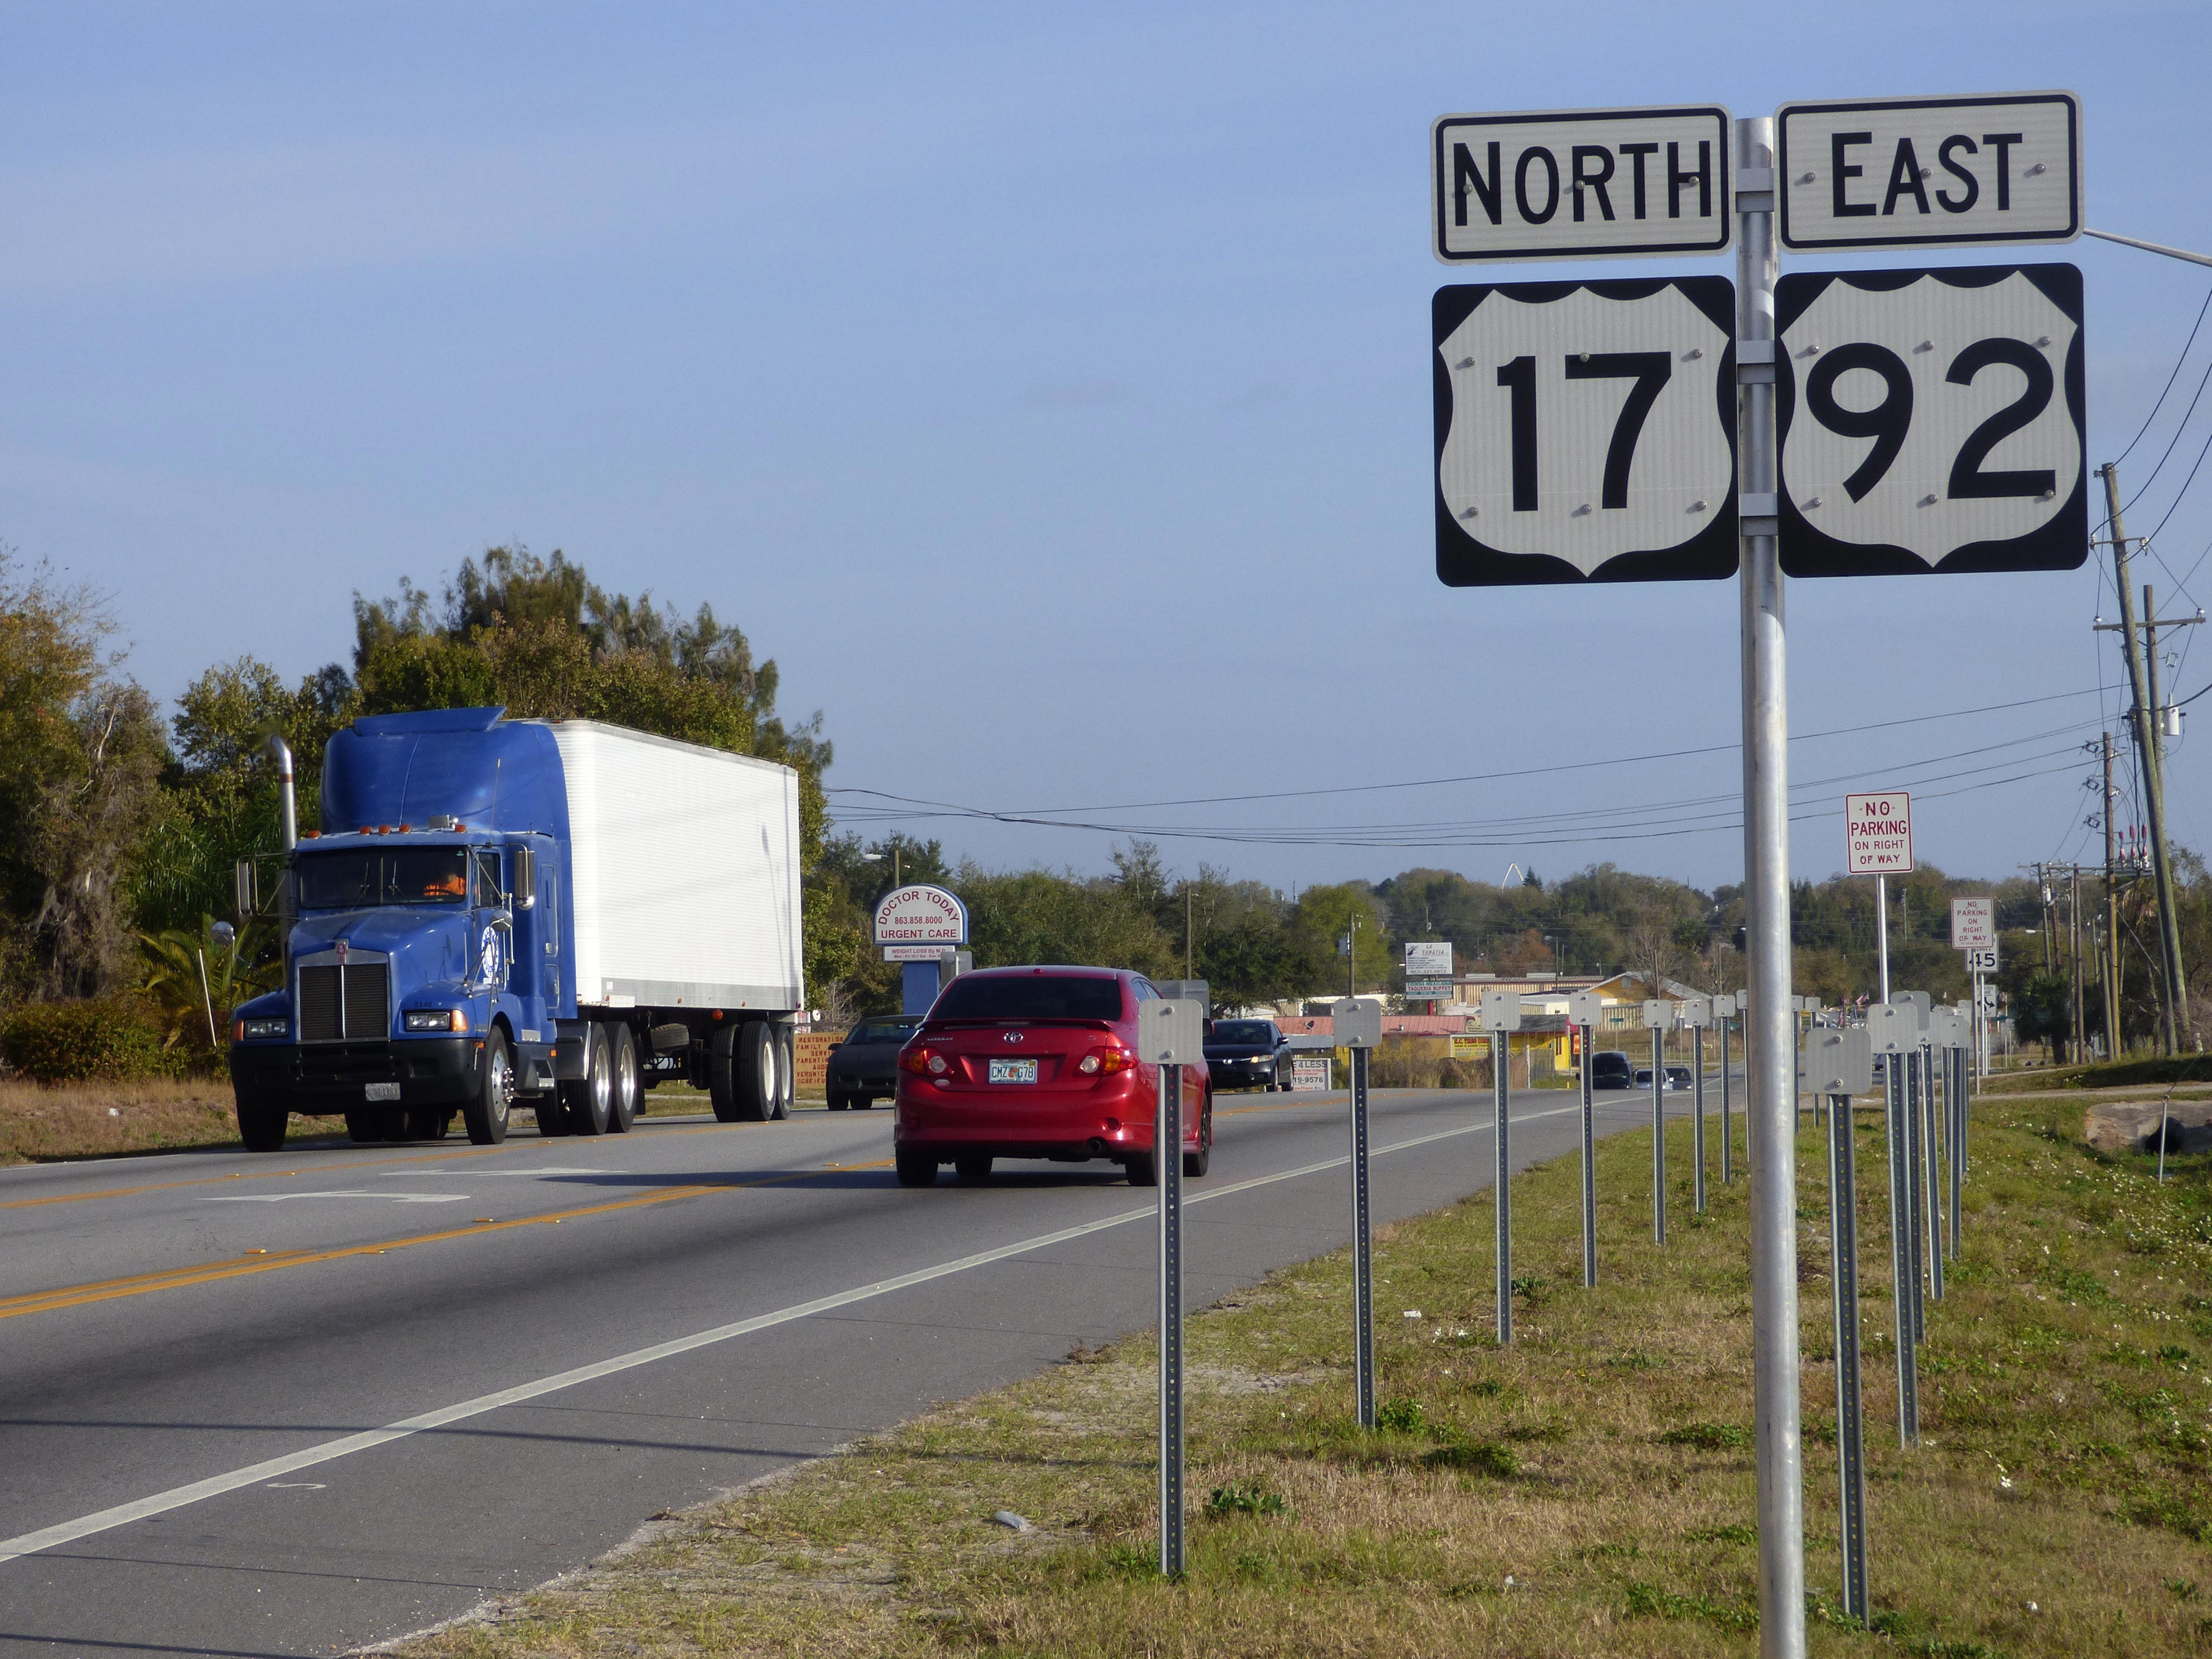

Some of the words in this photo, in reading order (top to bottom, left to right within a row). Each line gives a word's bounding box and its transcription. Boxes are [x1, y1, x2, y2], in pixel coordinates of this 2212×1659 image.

[1831, 132, 2023, 218] EAST
[1453, 140, 1712, 226] NORTH
[1805, 337, 2056, 504] 92
[1496, 351, 1672, 512] 17
[1866, 801, 1890, 816] NO
[1851, 820, 1907, 836] PARKING
[1855, 841, 1869, 850] ON
[1874, 840, 1904, 849] RIGHT
[1860, 855, 1873, 864] OF
[1877, 854, 1900, 864] WAY
[879, 891, 919, 924] DOCTOR
[926, 892, 960, 921] TODAY
[881, 930, 923, 938] URGENT
[1969, 953, 1995, 967] 45
[992, 1067, 1007, 1078] CMZ
